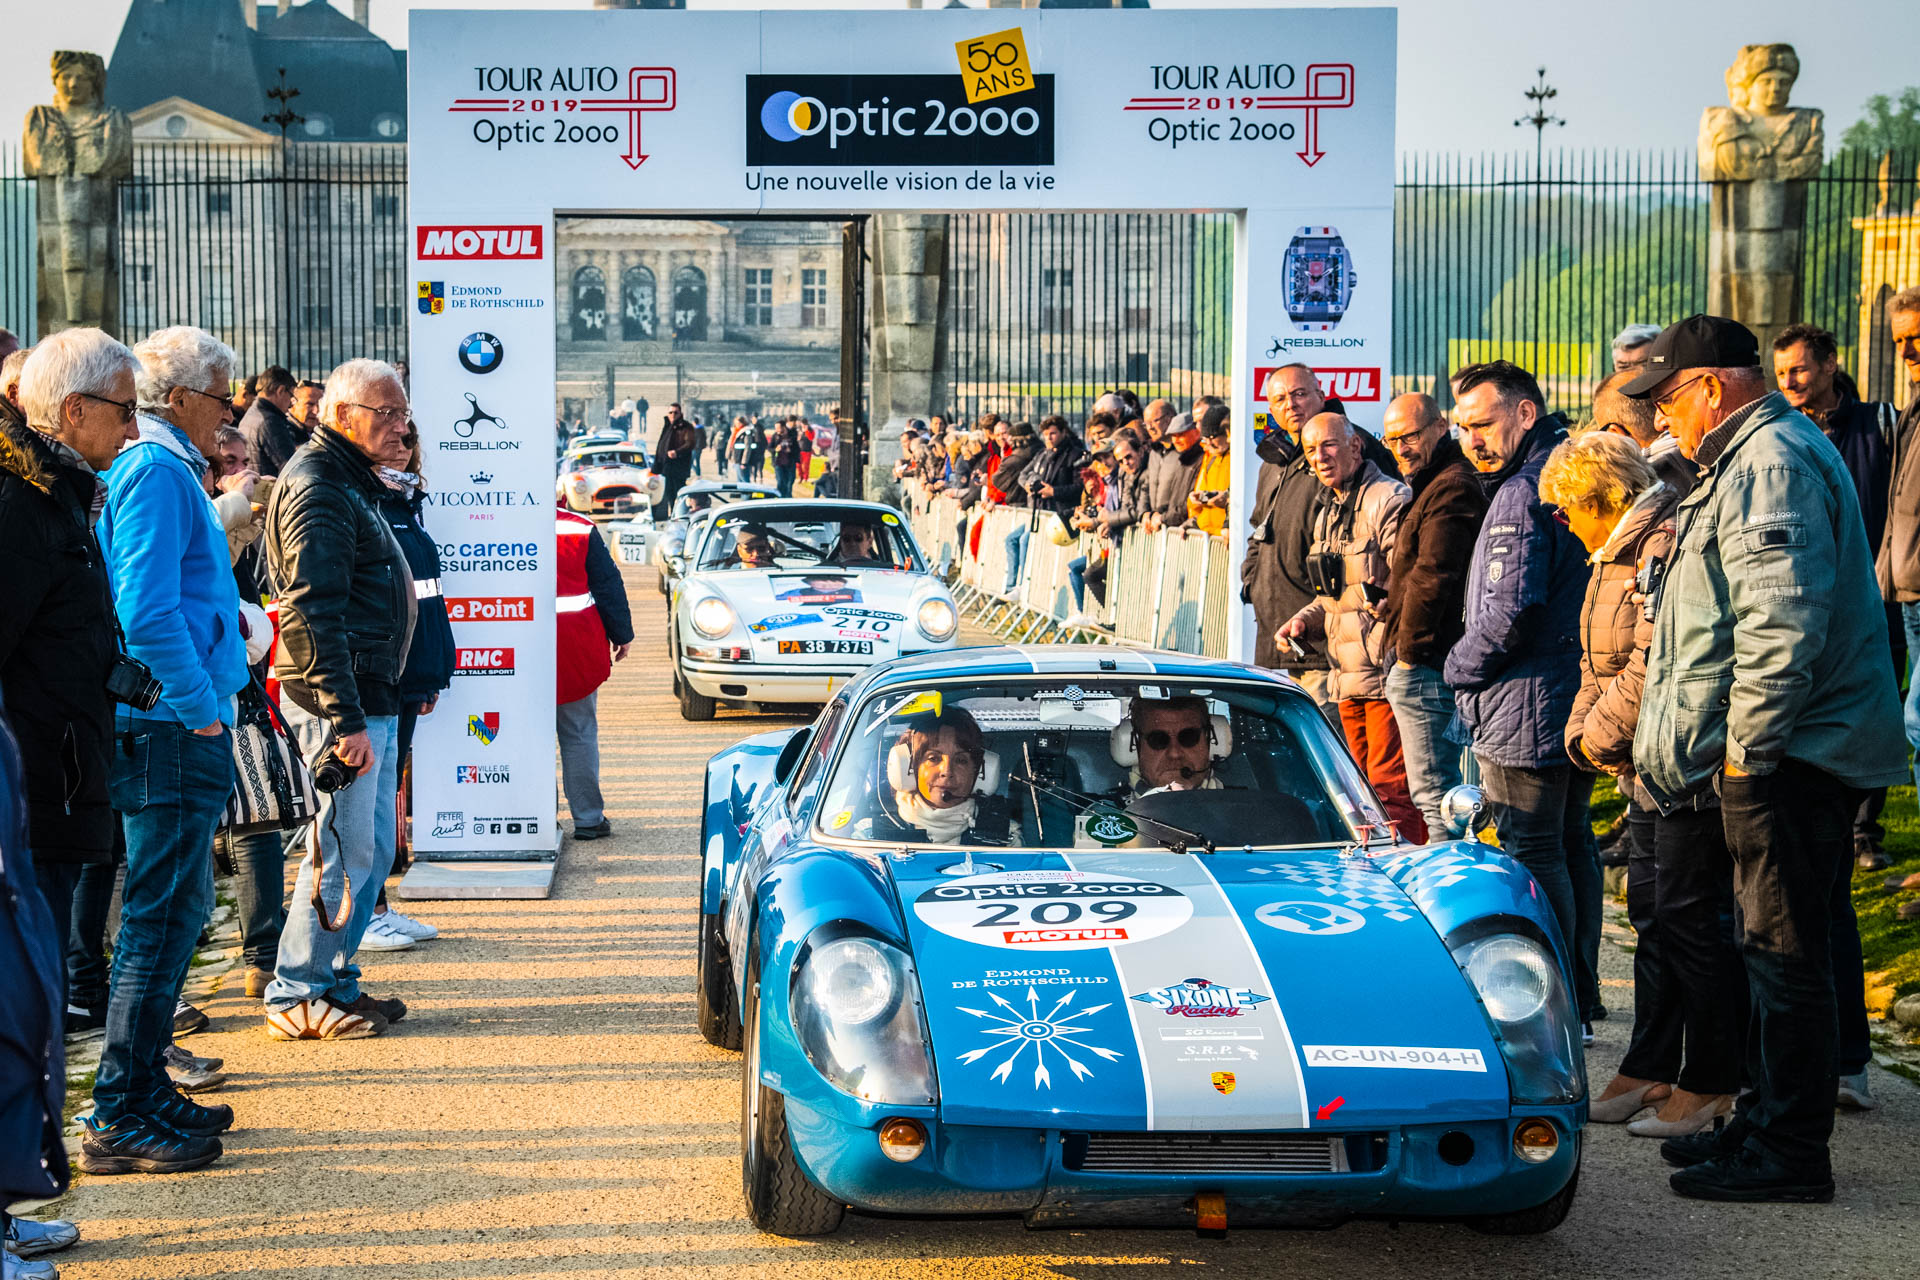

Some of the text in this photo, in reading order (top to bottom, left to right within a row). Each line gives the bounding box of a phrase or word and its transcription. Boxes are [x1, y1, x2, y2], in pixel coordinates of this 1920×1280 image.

[968, 42, 1018, 73] 50
[474, 66, 618, 92] TOUR AUTO
[974, 67, 1025, 98] ANS
[1151, 64, 1295, 90] TOUR AUTO
[512, 98, 578, 112] 2019
[1188, 97, 1254, 110] 2019
[788, 96, 1040, 148] Optic 2000
[473, 118, 619, 150] Optic 2000
[1148, 116, 1295, 149] Optic 2000
[746, 172, 1055, 191] Une nouvelle vision de la vie
[422, 230, 538, 256] MOTUL
[451, 285, 502, 296] EDMOND
[451, 298, 544, 309] DE ROTHSCHILD
[463, 333, 500, 347] BMW
[1259, 372, 1375, 398] TUL
[426, 491, 540, 507] VICOMTE A.
[459, 542, 538, 557] carene
[624, 547, 640, 561] 212
[468, 599, 527, 618] Point
[824, 606, 863, 616] Optic
[832, 616, 890, 631] 210
[779, 640, 871, 654] PA 38 7379
[460, 650, 503, 667] RMC
[468, 668, 487, 676] TALK
[467, 723, 499, 740] Dijon
[478, 773, 510, 784] LYON
[437, 813, 462, 821] PETER
[934, 883, 1163, 900] Optic 2000
[972, 901, 1138, 928] 209
[1008, 929, 1123, 942] MOTUL
[985, 968, 1071, 978] EDMOND
[952, 976, 1109, 989] DE ROTHSCHILD
[1149, 988, 1257, 1010] SIXONE
[1166, 1005, 1245, 1018] Racing
[1184, 1045, 1232, 1055] S.R.P.
[1313, 1048, 1479, 1066] AC-UN-904-H
